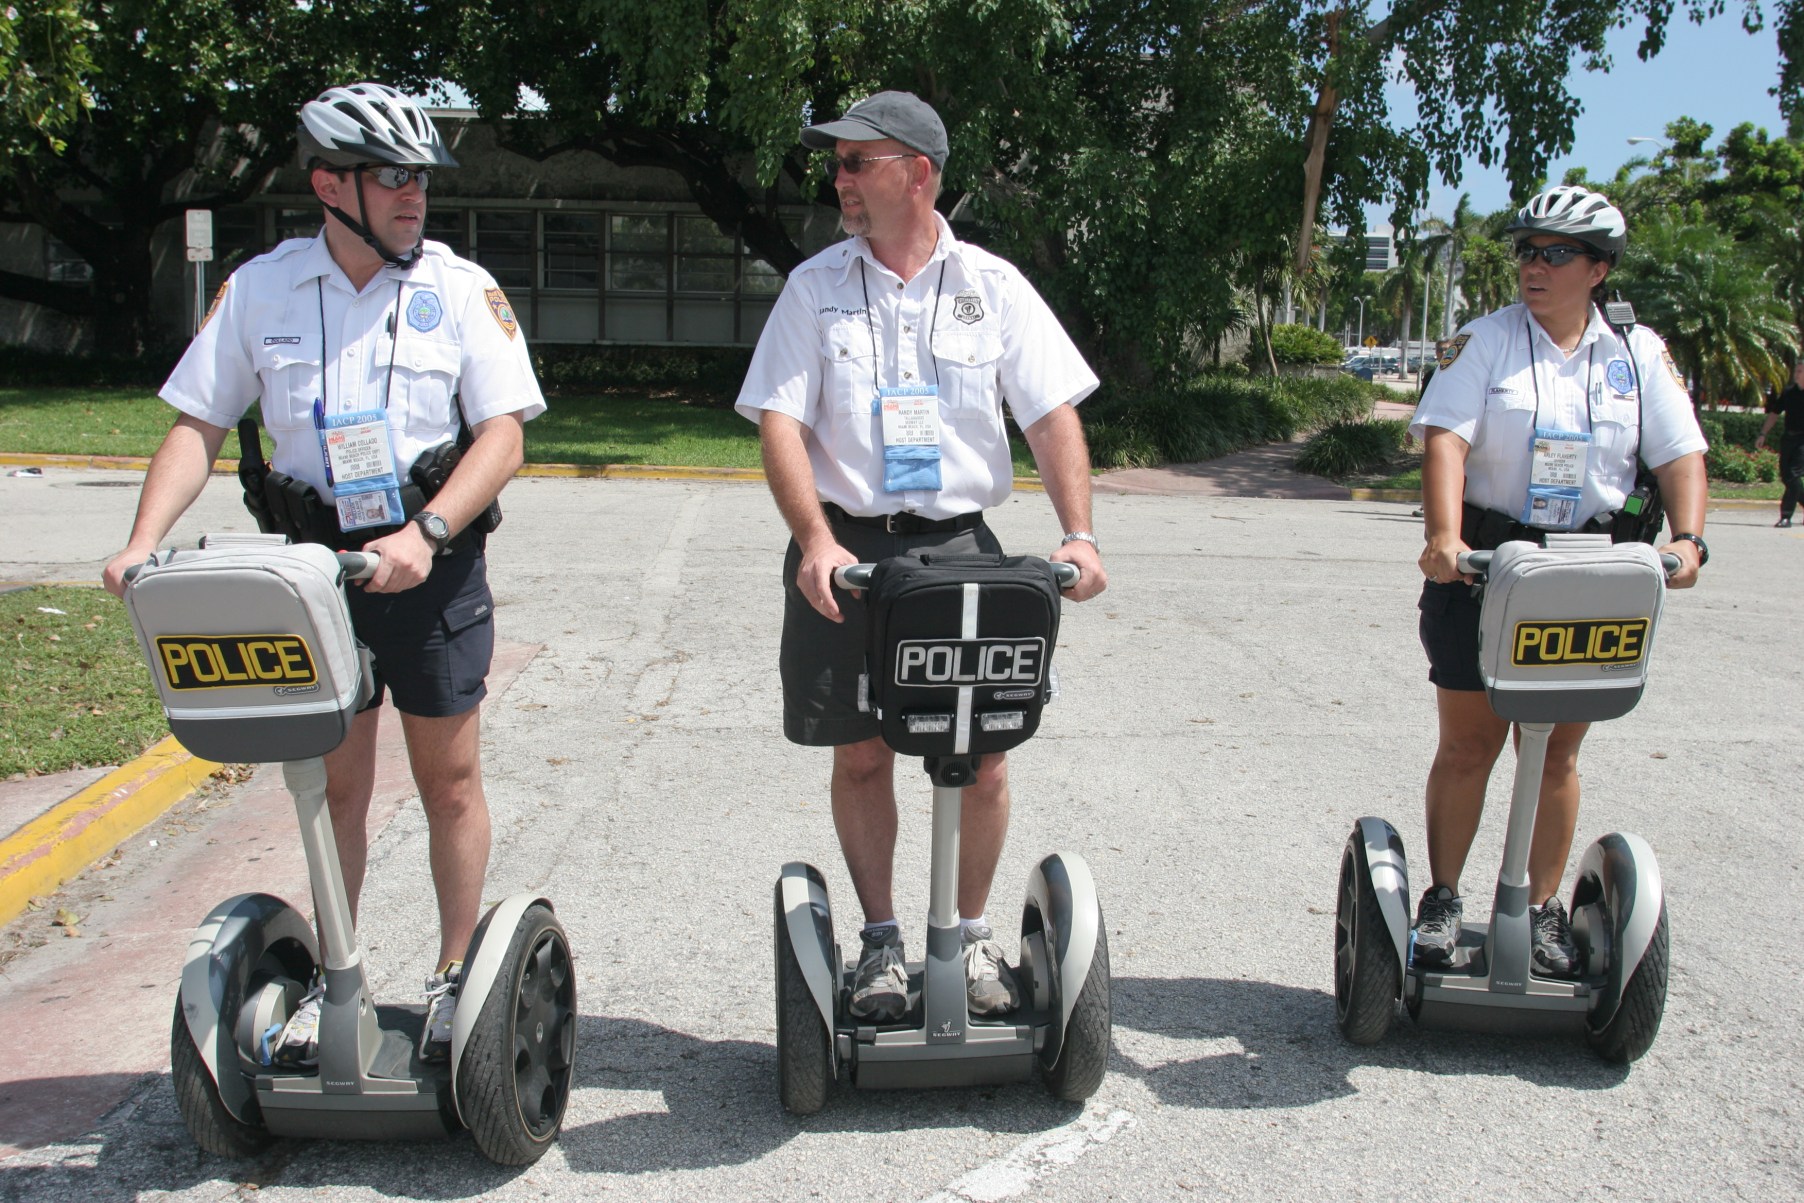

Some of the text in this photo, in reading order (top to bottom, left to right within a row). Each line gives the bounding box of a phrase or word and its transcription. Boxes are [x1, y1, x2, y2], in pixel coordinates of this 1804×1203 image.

[841, 308, 867, 316] Martin
[910, 387, 929, 395] 2005
[332, 413, 377, 427] IACP 2005
[338, 441, 357, 450] WILLIAM
[342, 472, 353, 480] HOST
[354, 467, 384, 478] DEPARTMENT
[1516, 624, 1644, 661] POLICE
[161, 641, 310, 684] POLICE
[901, 644, 1039, 682] POLICE
